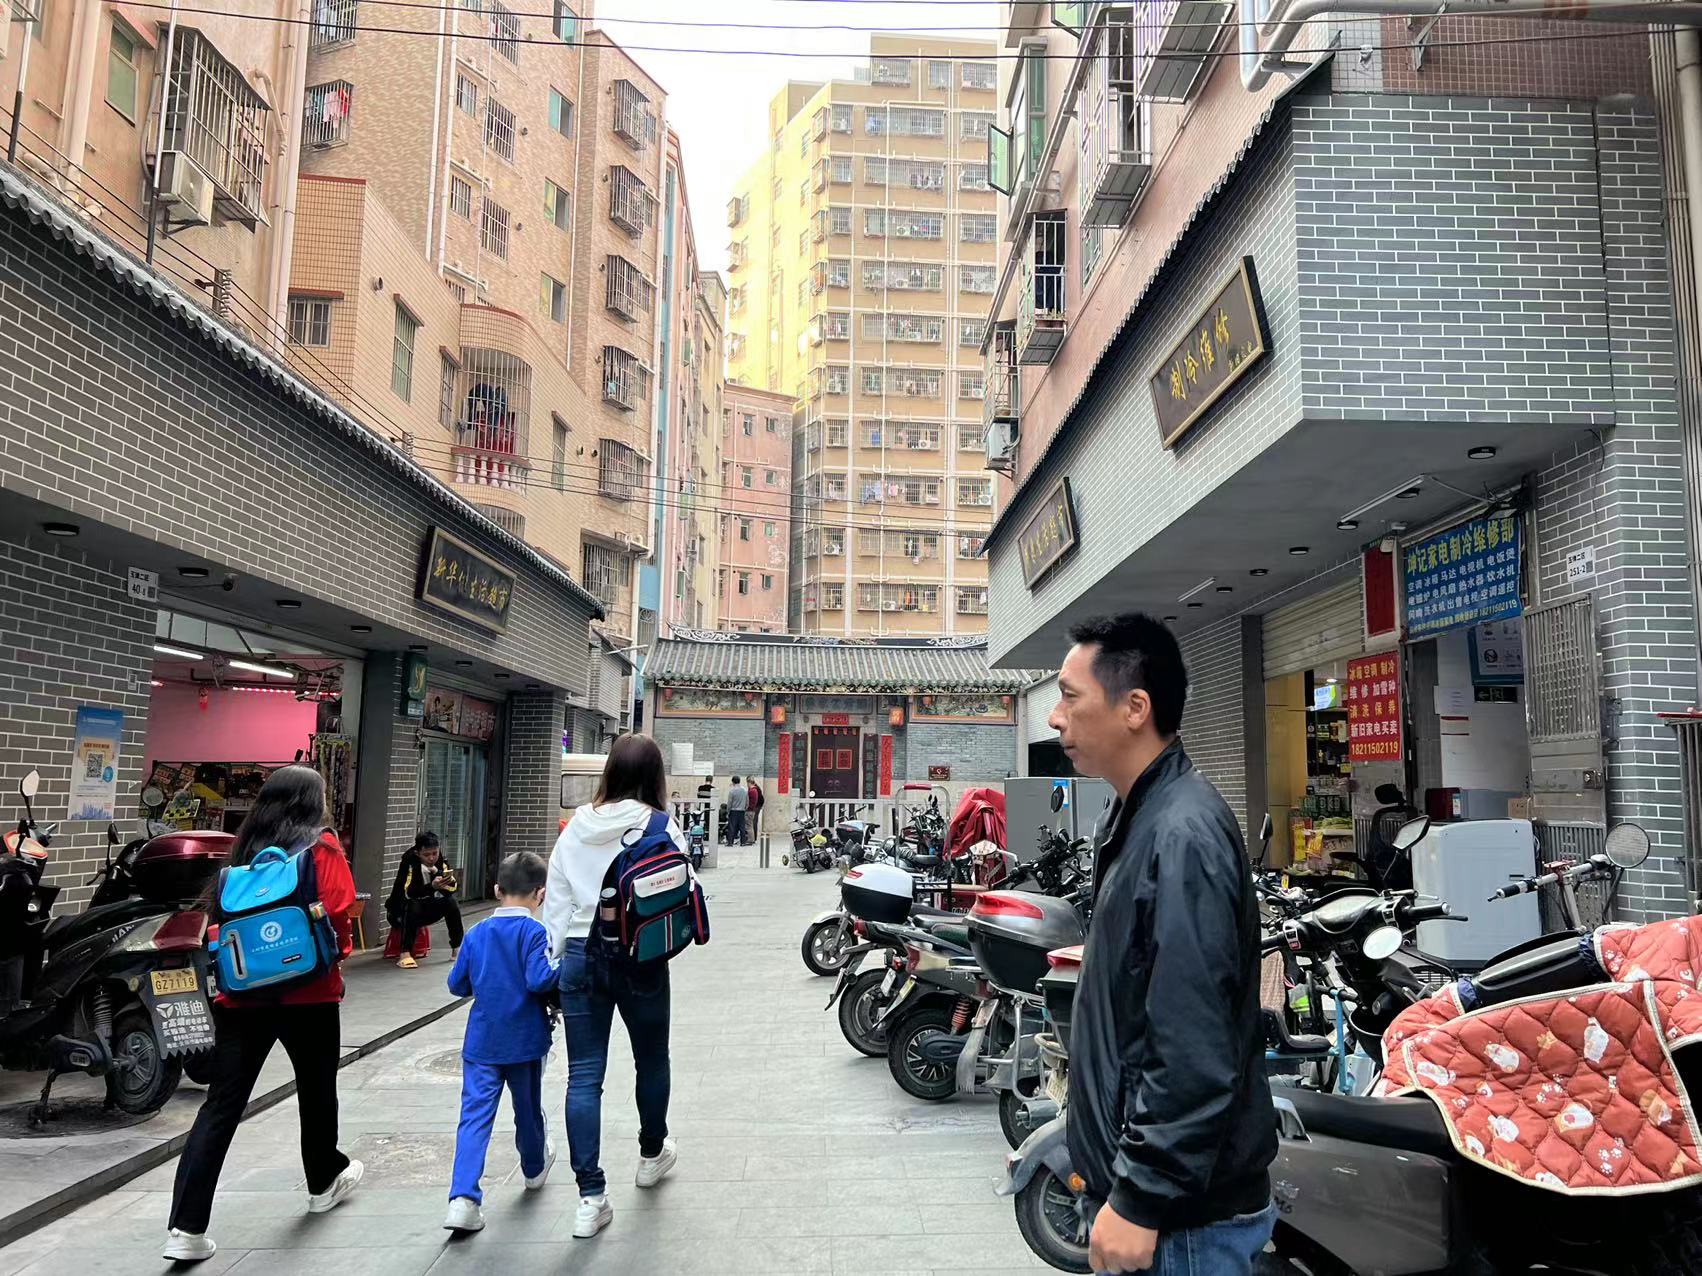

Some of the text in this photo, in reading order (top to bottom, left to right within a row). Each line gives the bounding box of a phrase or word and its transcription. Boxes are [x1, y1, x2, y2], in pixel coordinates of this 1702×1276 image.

[1407, 517, 1515, 577] 坤记家电制冷维修部
[1350, 720, 1398, 737] 新旧家电买卖
[1351, 741, 1399, 755] 18211502119
[155, 977, 195, 991] GZ7119
[173, 1000, 206, 1017] 雅迪
